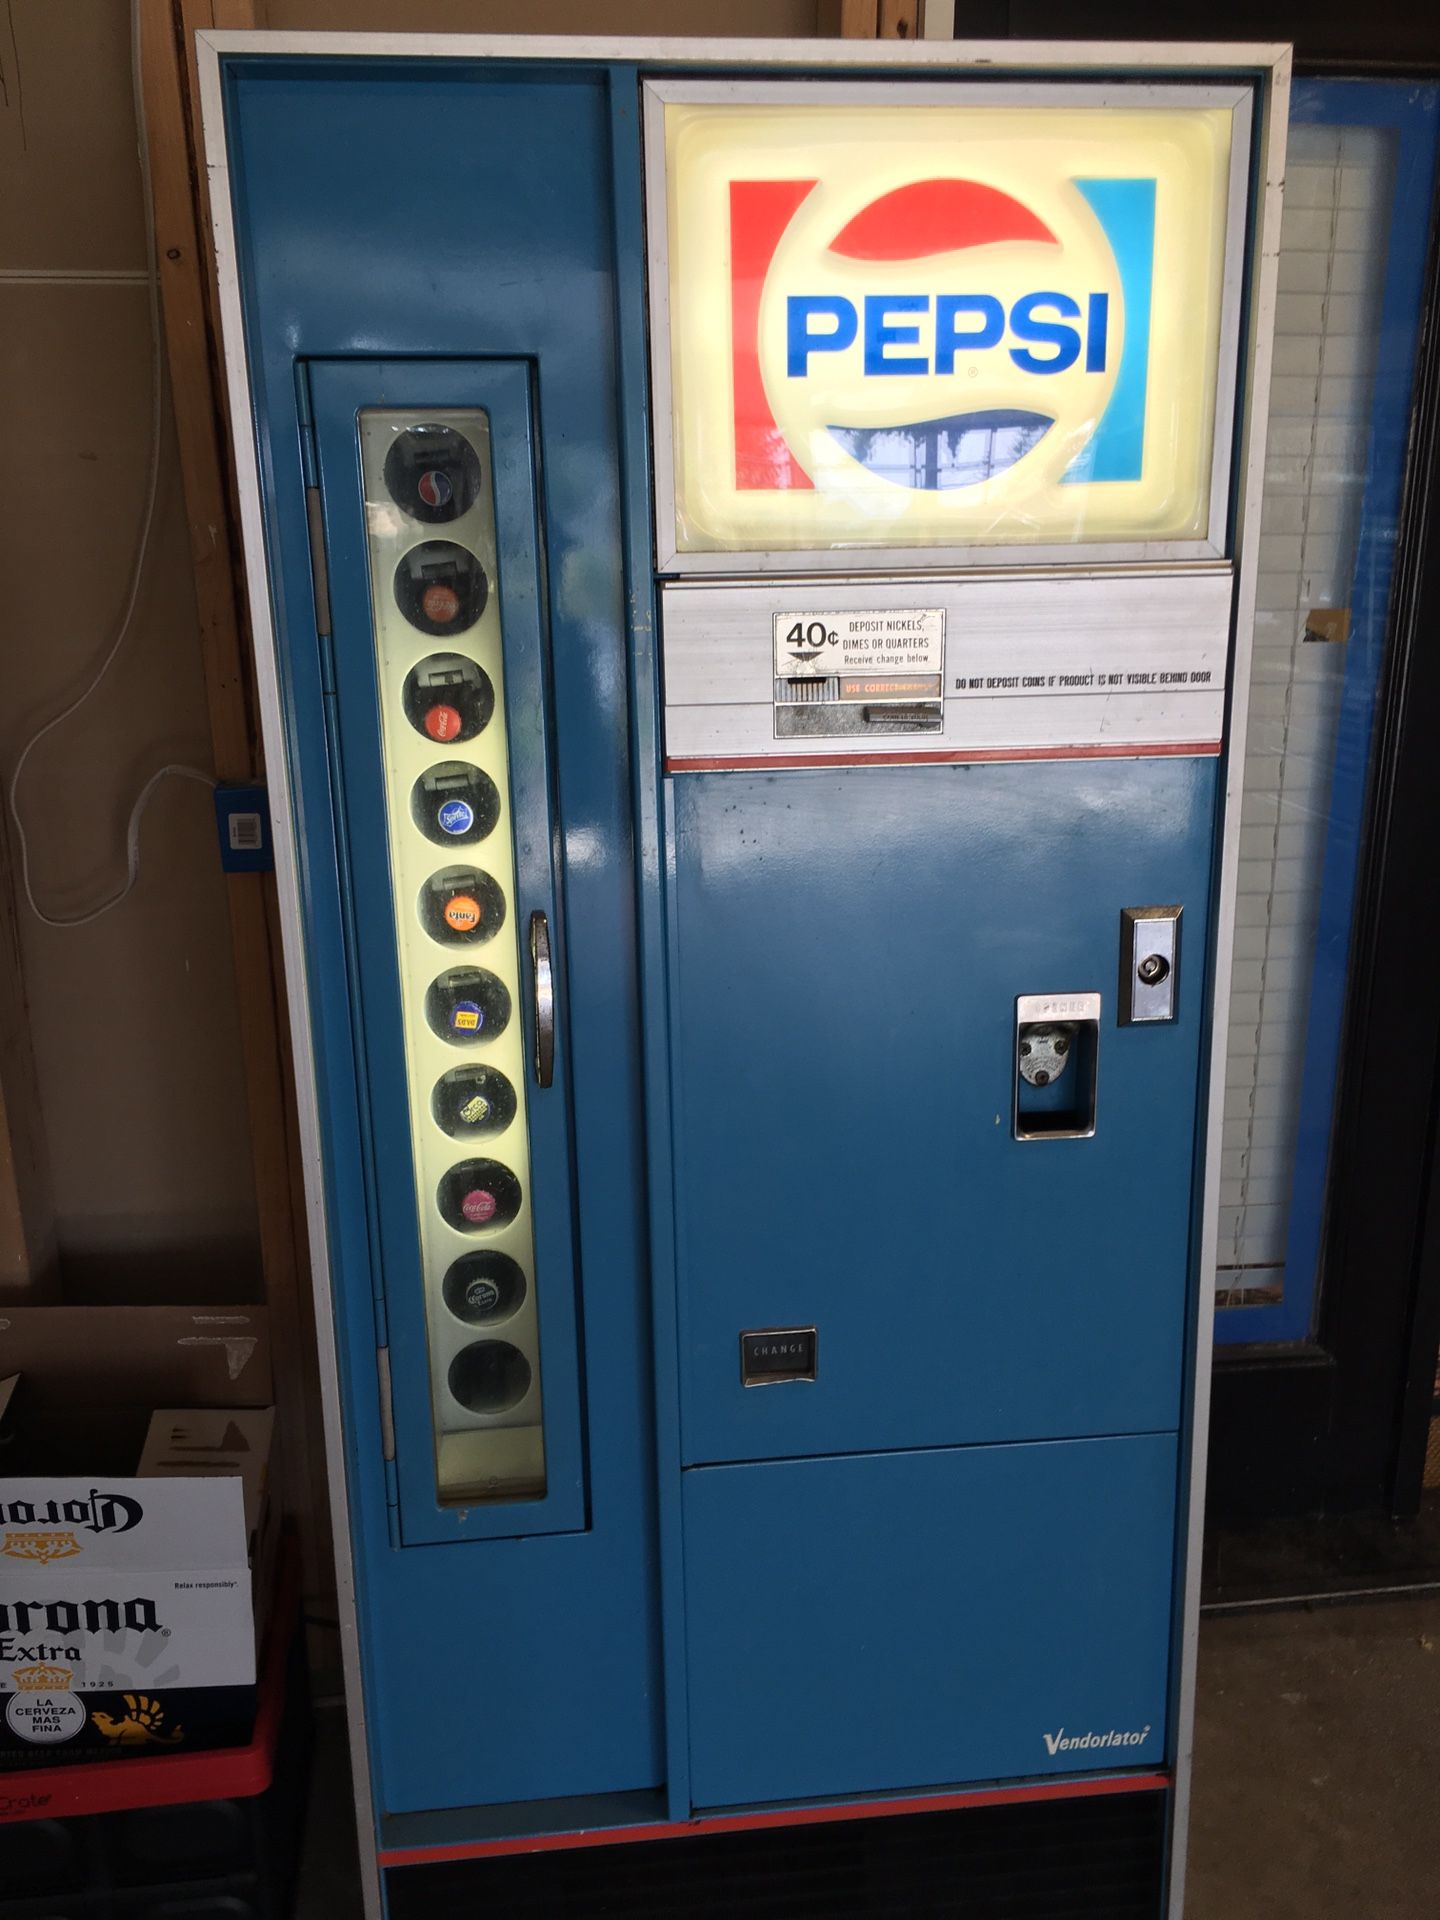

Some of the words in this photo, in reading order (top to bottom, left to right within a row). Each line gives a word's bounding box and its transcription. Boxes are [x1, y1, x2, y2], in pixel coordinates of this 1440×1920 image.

[786, 291, 1109, 379] PEPSI
[849, 621, 883, 632] DEPOSIT
[887, 620, 925, 632] NICKELS,
[786, 622, 839, 648] 40¢
[842, 638, 869, 650] DIMES
[872, 638, 883, 649] OR
[886, 637, 929, 649] QUARTERS
[844, 655, 873, 664] Receive
[877, 654, 903, 666] change
[907, 653, 928, 663] below
[955, 678, 966, 689] DO
[969, 677, 984, 689] NOT
[987, 677, 1019, 688] DEPOSIT
[1022, 676, 1045, 687] COINS
[1048, 675, 1056, 686] IF
[1059, 674, 1094, 686] PRODUCT
[1098, 674, 1106, 685] IS
[1108, 673, 1123, 685] NOT
[1127, 672, 1157, 684] VISIBLE
[1160, 671, 1188, 683] BEHIND
[1191, 671, 1211, 683] DOOR
[845, 684, 860, 693] USE
[753, 1343, 803, 1356] CHANGE
[0, 1489, 143, 1533] Coro
[0, 1598, 163, 1635] rona
[37, 1699, 53, 1707] LA
[15, 1707, 76, 1716] CERVEZA
[32, 1716, 60, 1724] MAS
[32, 1725, 62, 1733] FINA
[1043, 1727, 1150, 1755] Vendorlator
